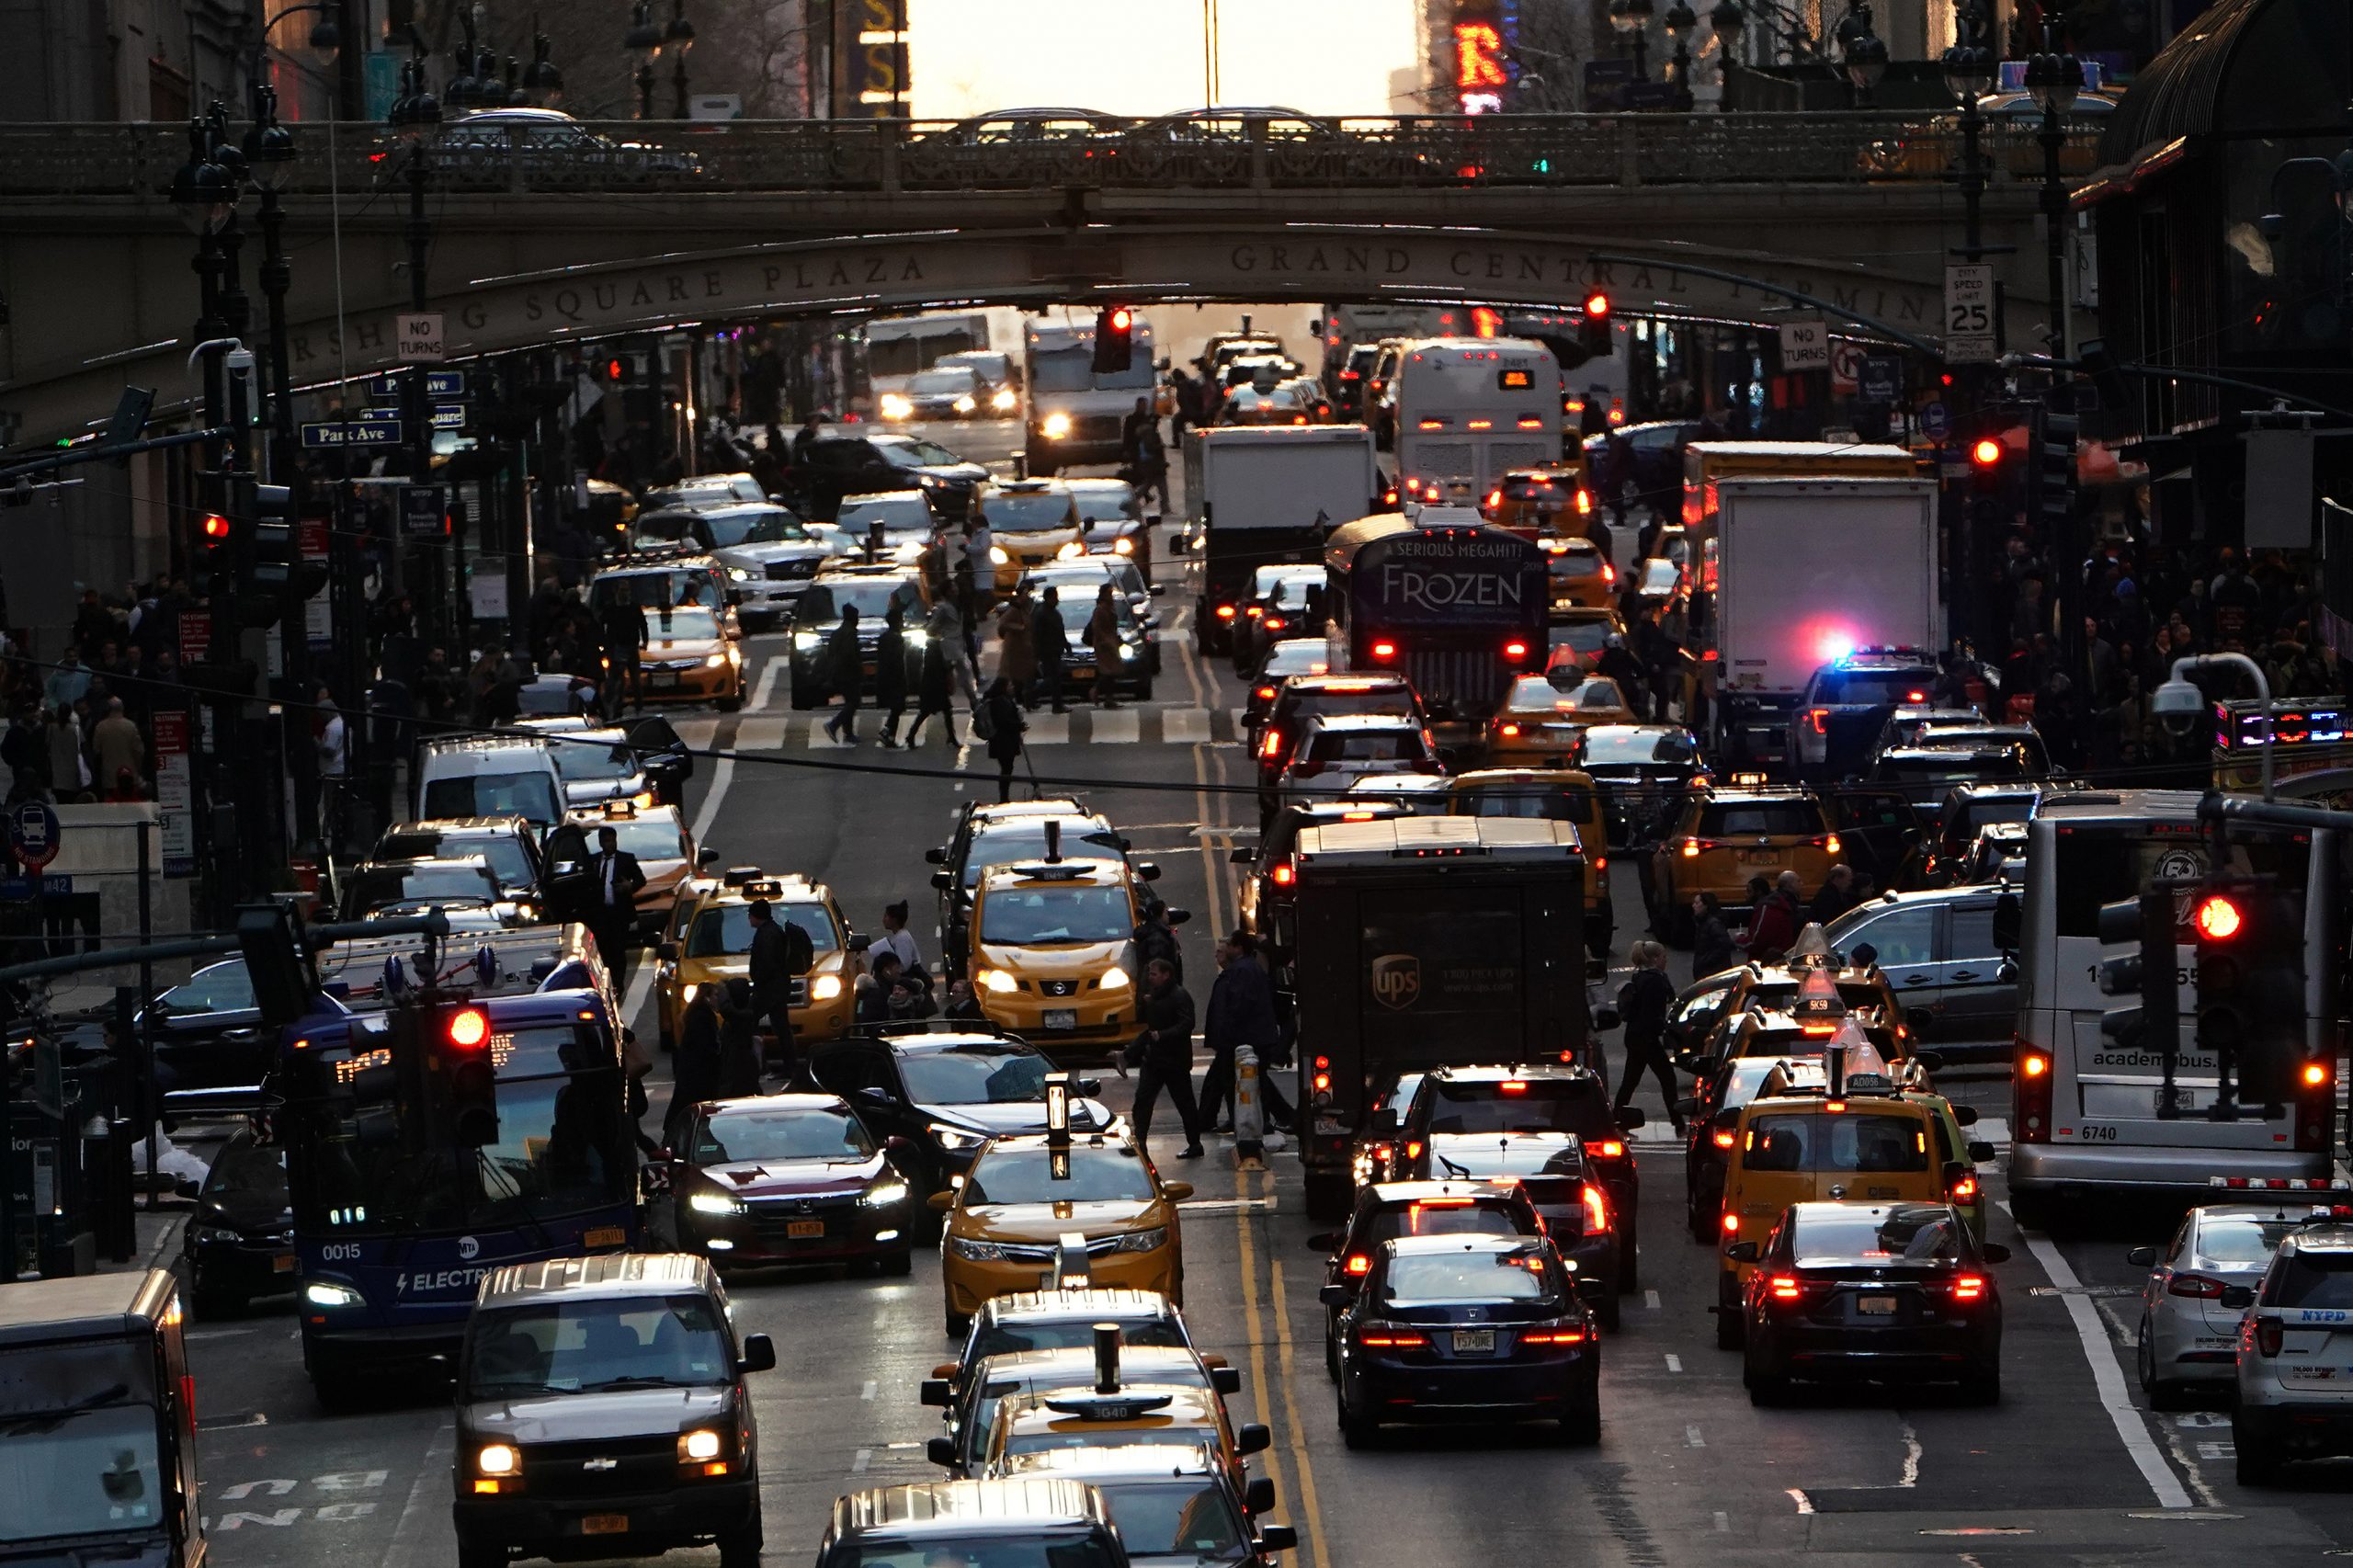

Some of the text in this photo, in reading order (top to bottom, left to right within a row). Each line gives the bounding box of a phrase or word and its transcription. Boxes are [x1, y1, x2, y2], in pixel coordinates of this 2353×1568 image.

[1232, 245, 1412, 274] GRAND
[1449, 251, 1688, 293] CENTRAL
[525, 272, 724, 322] SQUARE
[765, 256, 924, 291] PLAZA
[1954, 279, 1983, 290] SPEED
[1957, 291, 1981, 301] LIMIT
[1951, 304, 1988, 332] 25
[410, 322, 431, 335] NO
[1794, 329, 1814, 343] NO
[400, 342, 442, 355] TURNS
[1786, 347, 1827, 362] TURNS
[358, 426, 386, 440] Ave
[1396, 542, 1454, 557] SERIOUS
[1459, 543, 1523, 559] MEGAHIT!
[1381, 563, 1522, 612] FROZEN
[24, 846, 56, 864] STANDING
[43, 878, 67, 892] M42
[1377, 968, 1416, 1002] ups
[1443, 983, 1515, 994] www.ups.com
[2083, 1126, 2117, 1141] 6740
[330, 1206, 366, 1225] 016
[323, 1243, 361, 1261] 0015
[460, 1243, 478, 1256] MTA
[2301, 1310, 2347, 1322] NYPD
